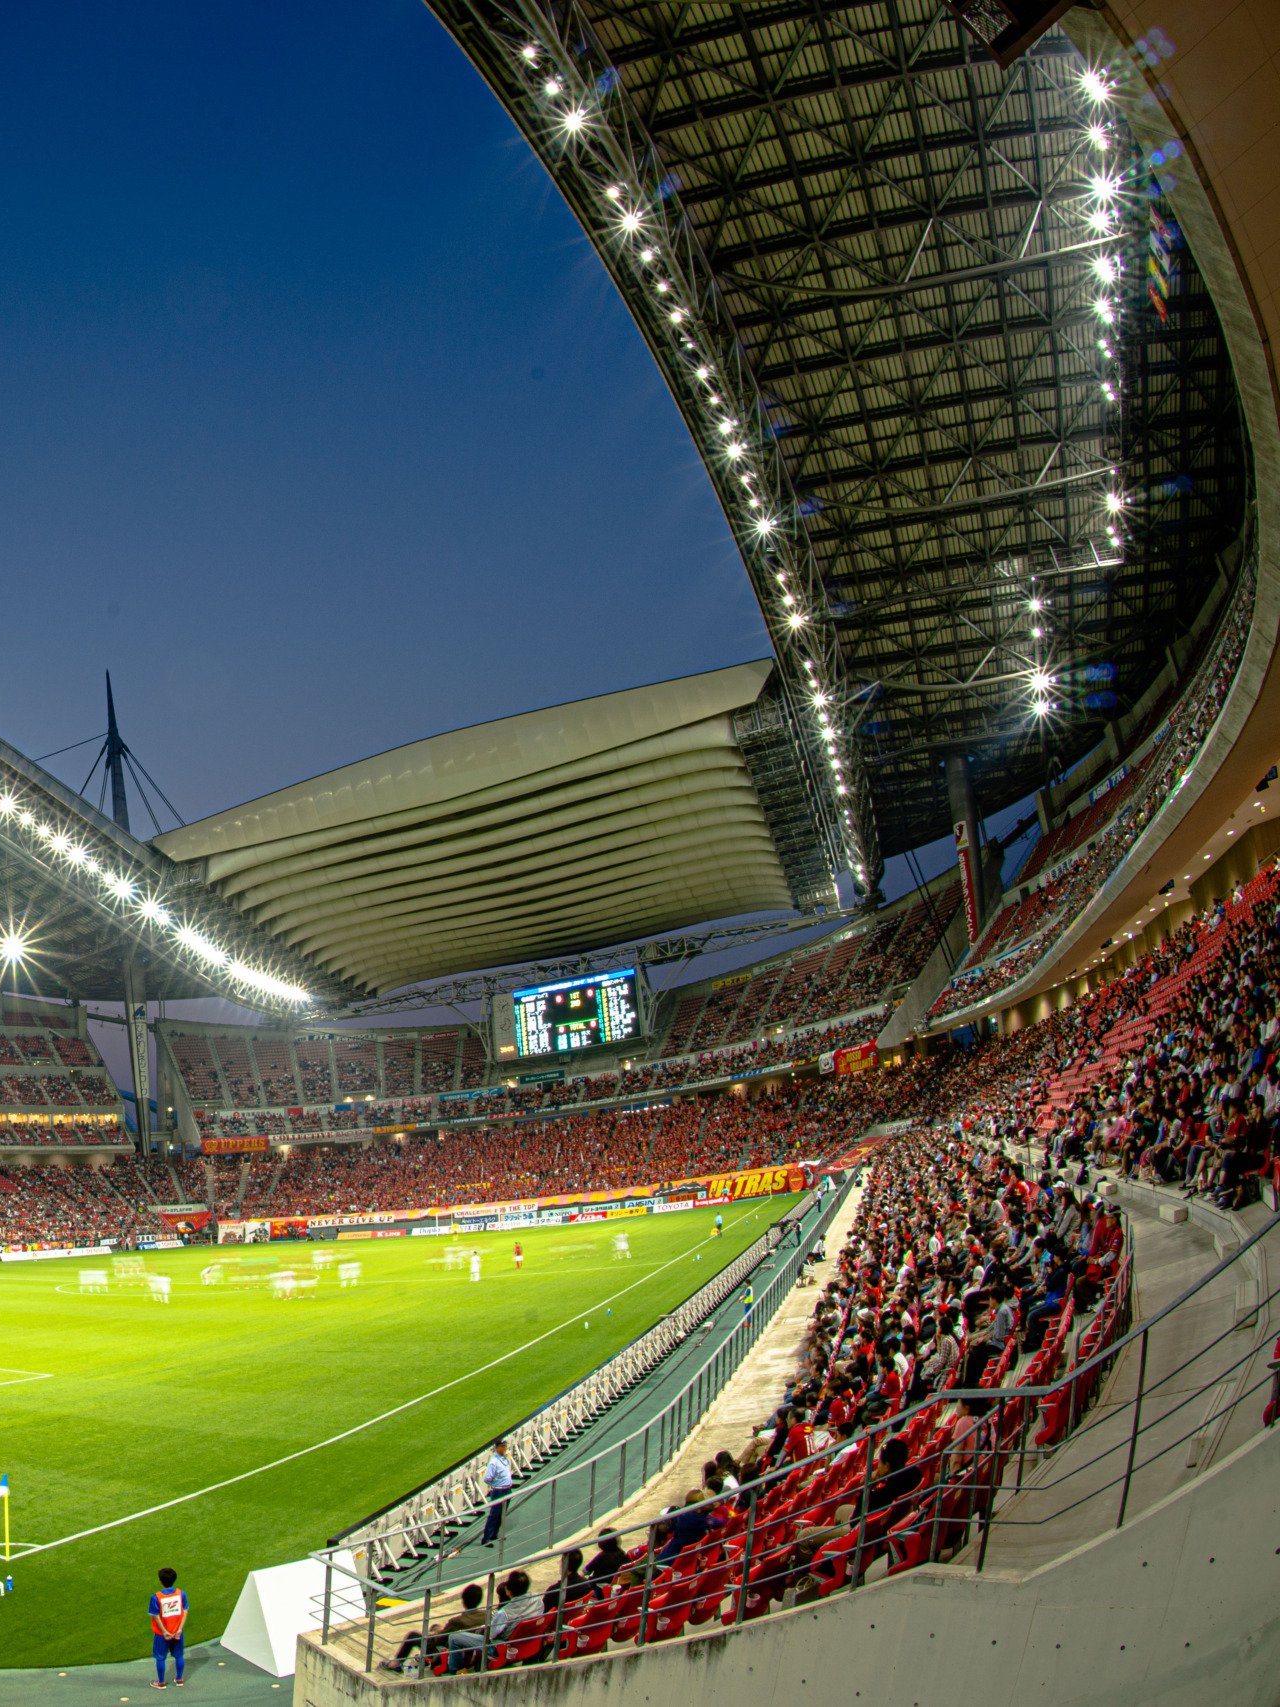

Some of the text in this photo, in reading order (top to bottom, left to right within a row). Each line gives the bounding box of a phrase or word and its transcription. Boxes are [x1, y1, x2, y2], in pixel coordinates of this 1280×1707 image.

[220, 1137, 266, 1150] UPPERS
[708, 1169, 788, 1199] ULTRAS
[657, 1202, 690, 1211] TOYOTA
[310, 1214, 393, 1227] NEVER GIVE UP
